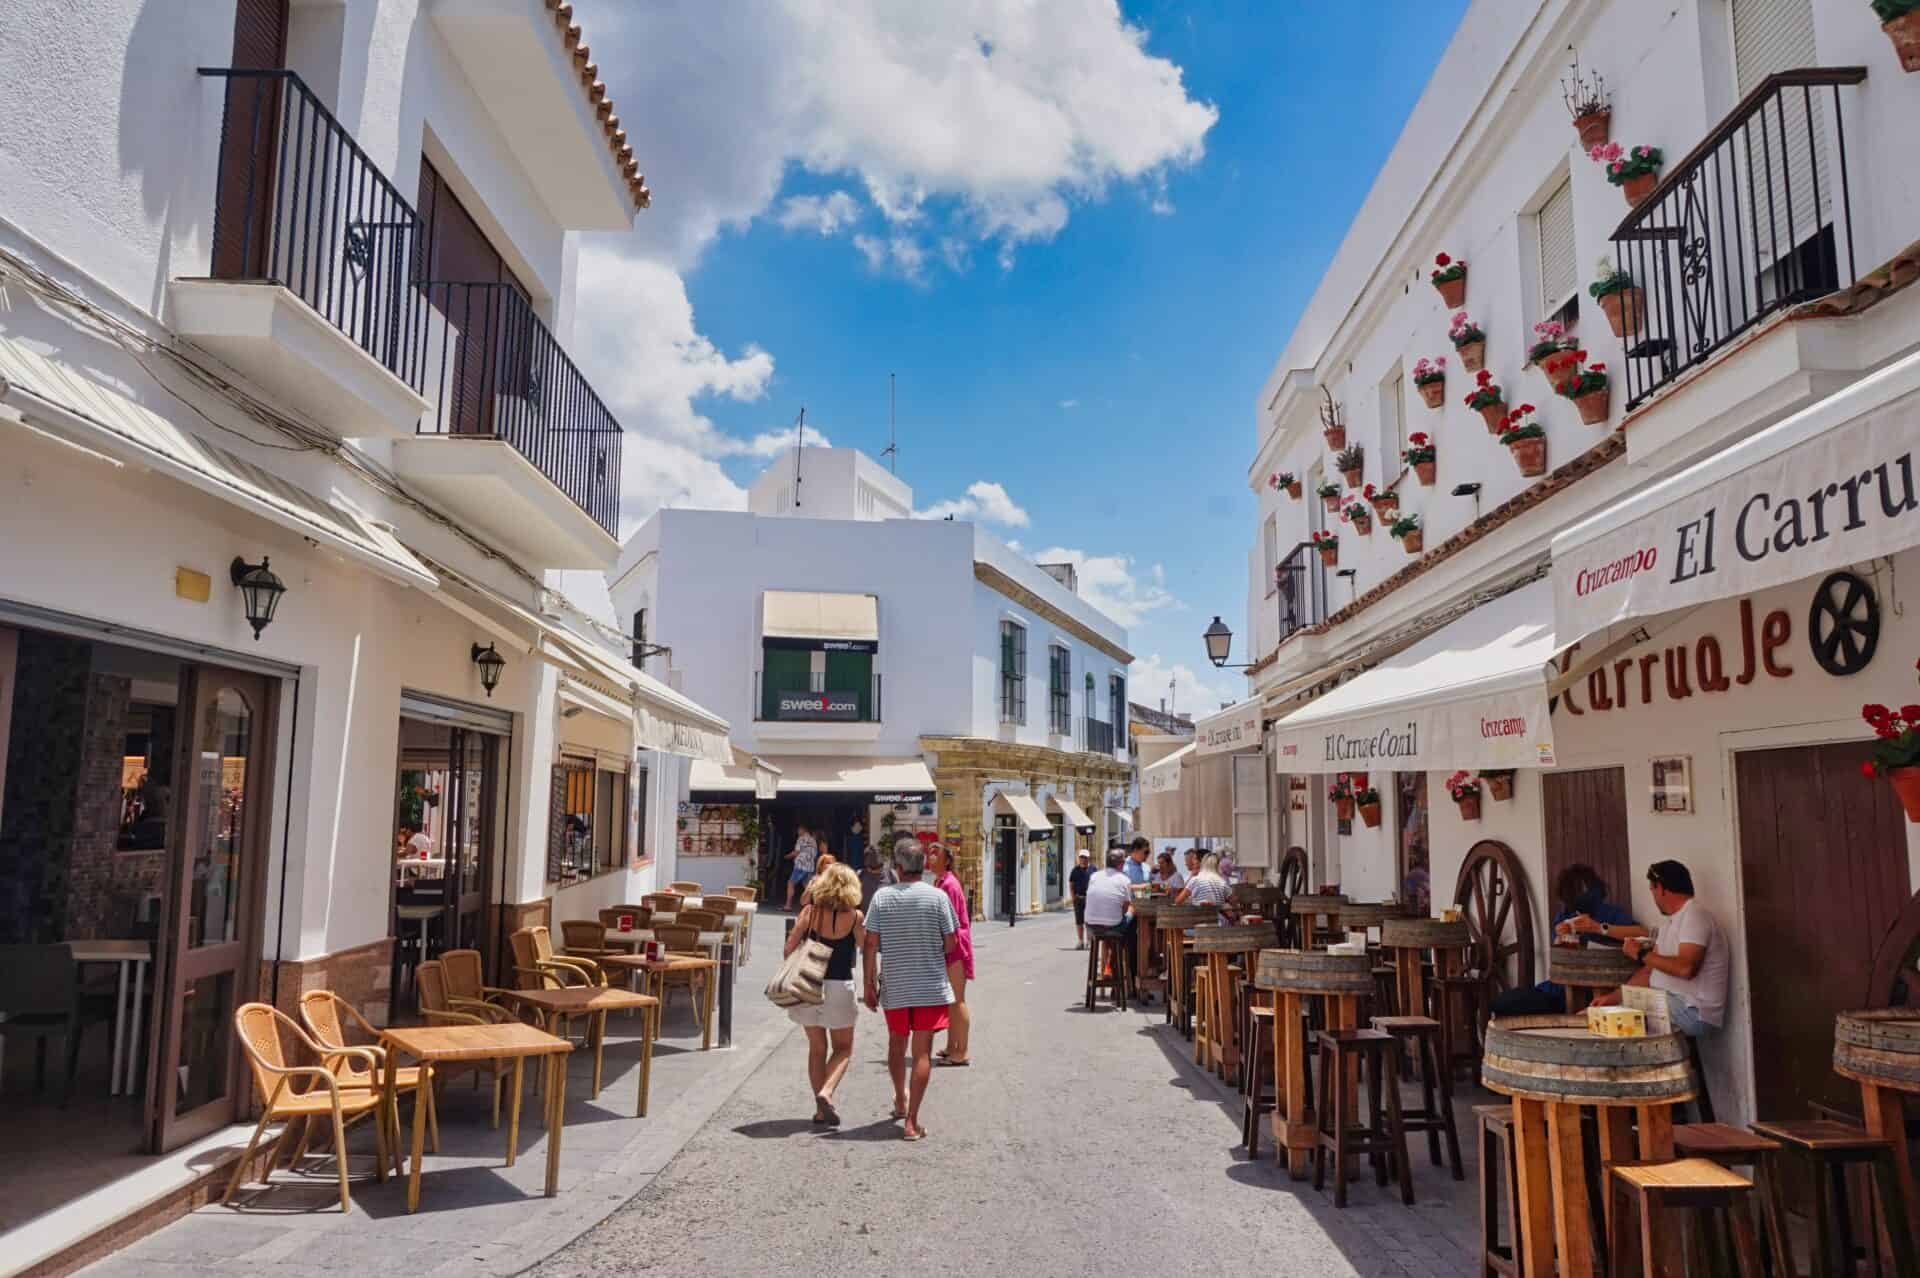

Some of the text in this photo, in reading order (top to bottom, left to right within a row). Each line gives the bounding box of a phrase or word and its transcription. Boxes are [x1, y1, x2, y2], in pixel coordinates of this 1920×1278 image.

[1669, 451, 1919, 585] El Carru
[1576, 546, 1658, 597] Cruzcampo
